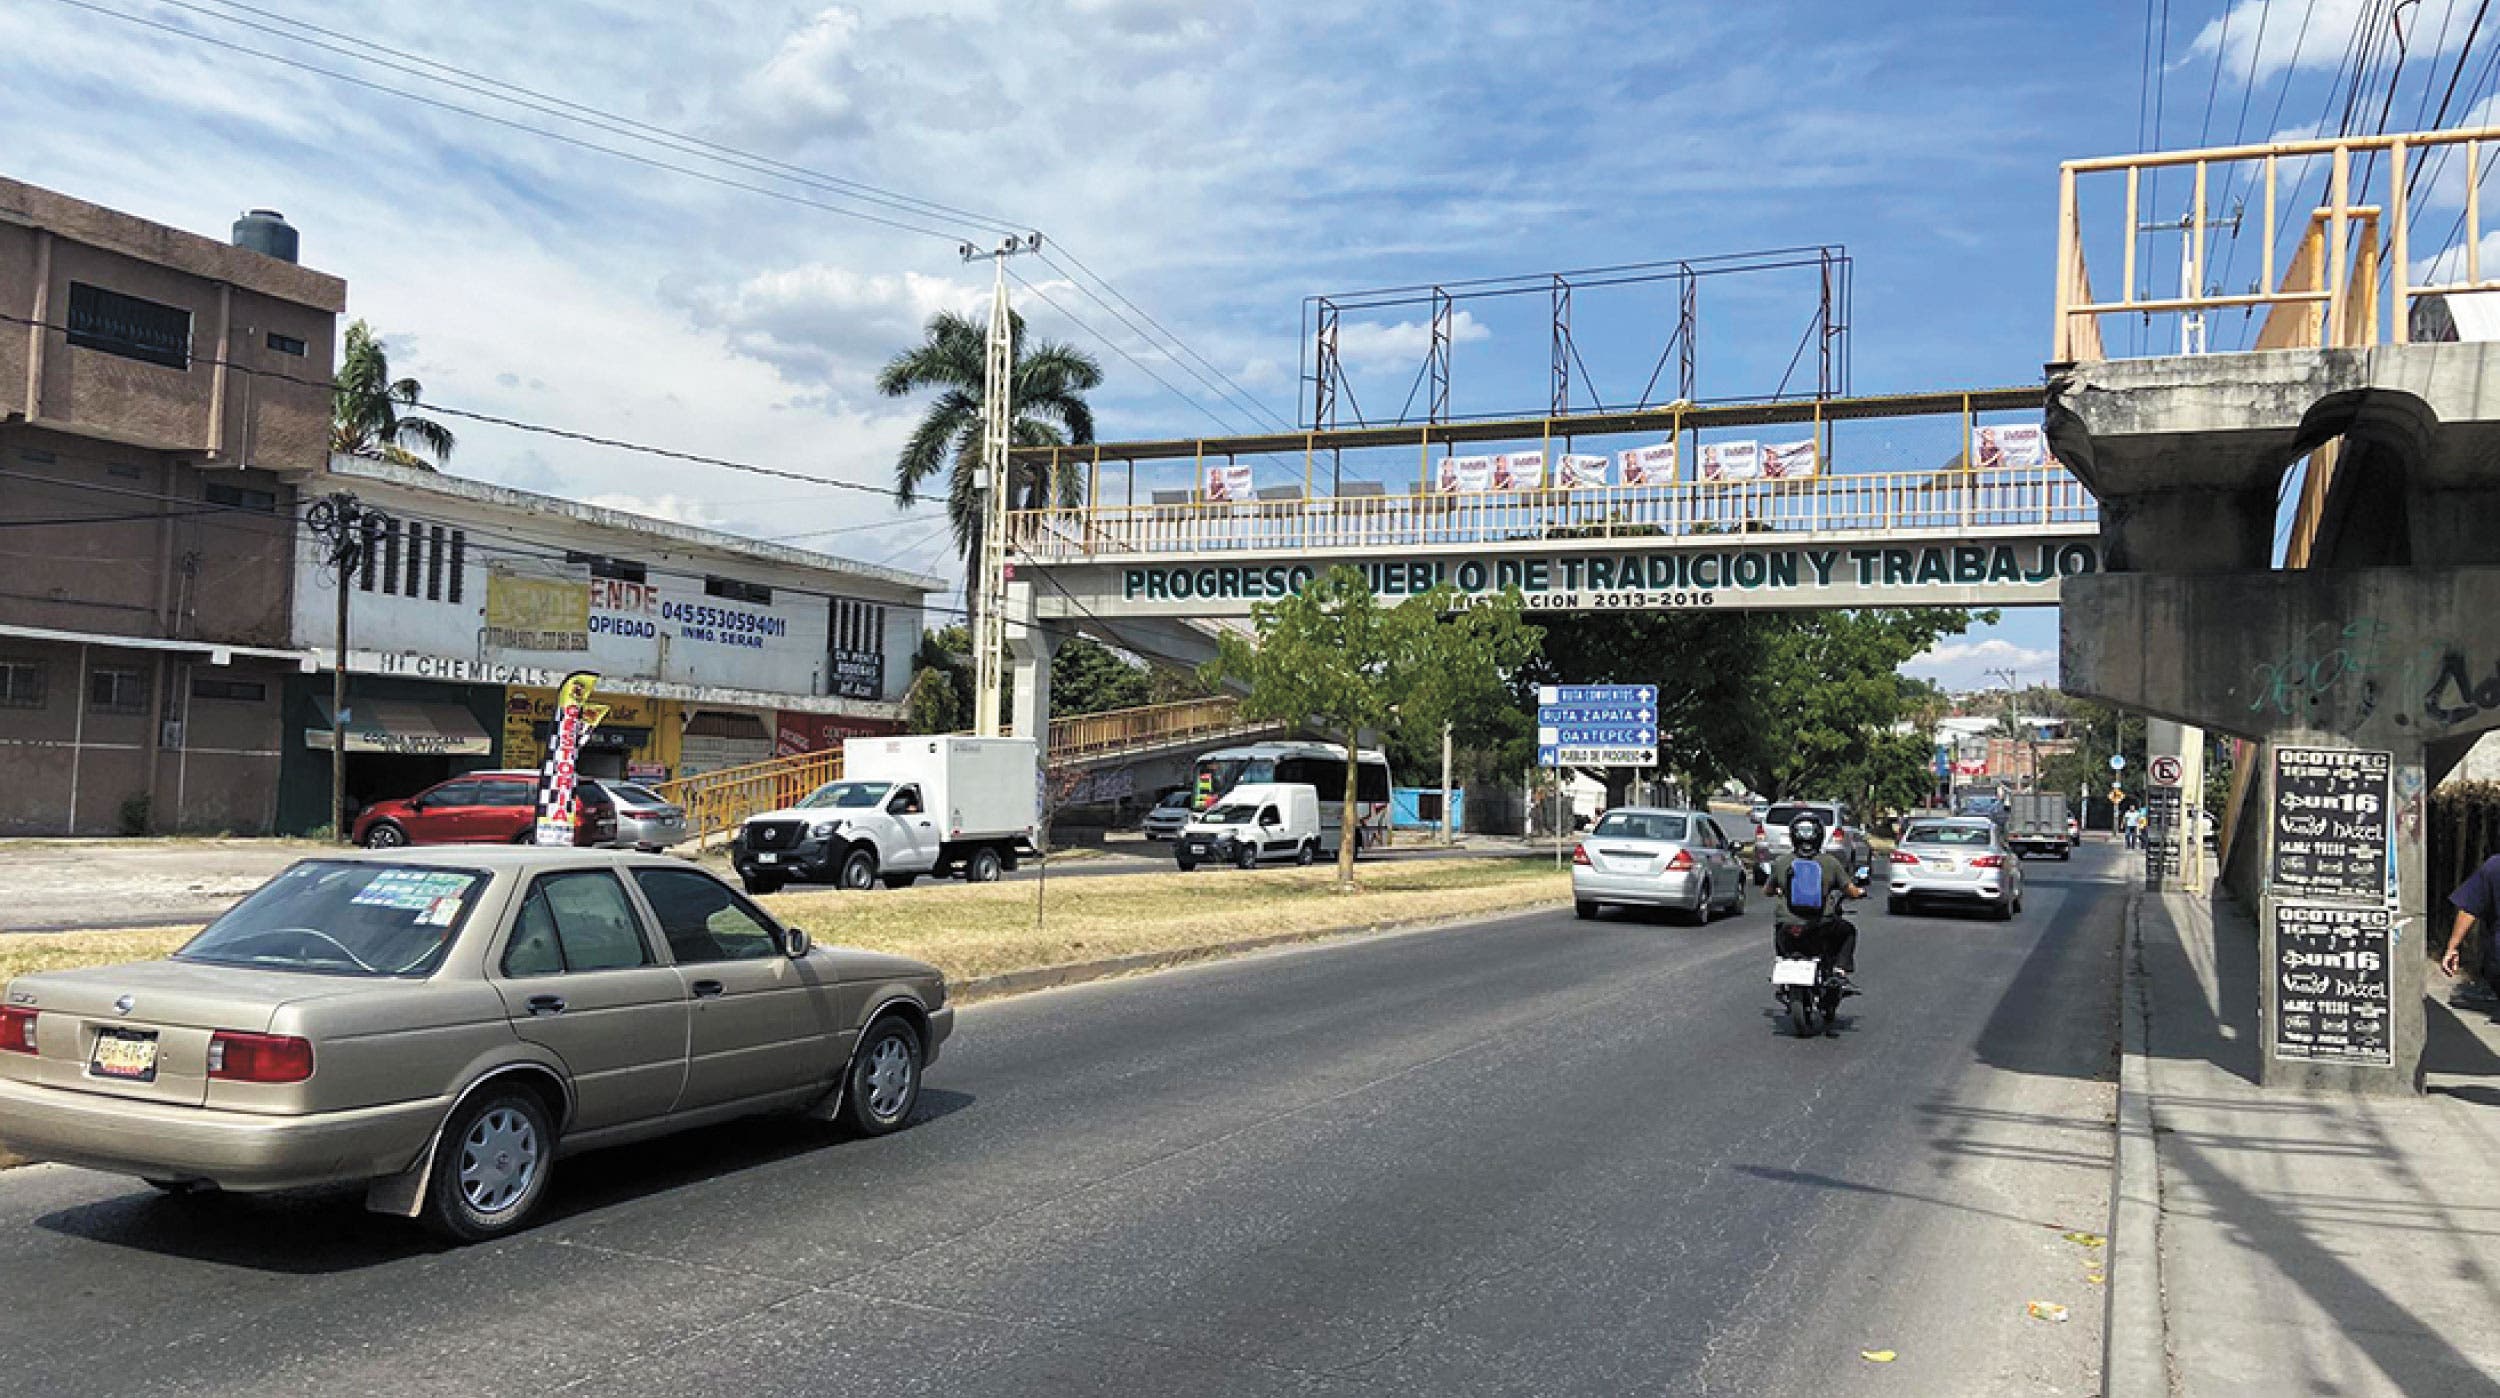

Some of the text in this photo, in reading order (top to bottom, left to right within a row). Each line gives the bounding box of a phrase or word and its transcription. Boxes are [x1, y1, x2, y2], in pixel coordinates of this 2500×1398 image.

[1123, 542, 2097, 601] PROGRESO UEBLO DE TRADICION Y TRABAJO
[590, 577, 659, 614] ENDE
[1594, 592, 1714, 607] 2013-2016
[589, 615, 656, 638] OPIEDAD
[417, 657, 548, 685] CHEMICALS
[1544, 710, 1633, 721] RUTA ZAPATA
